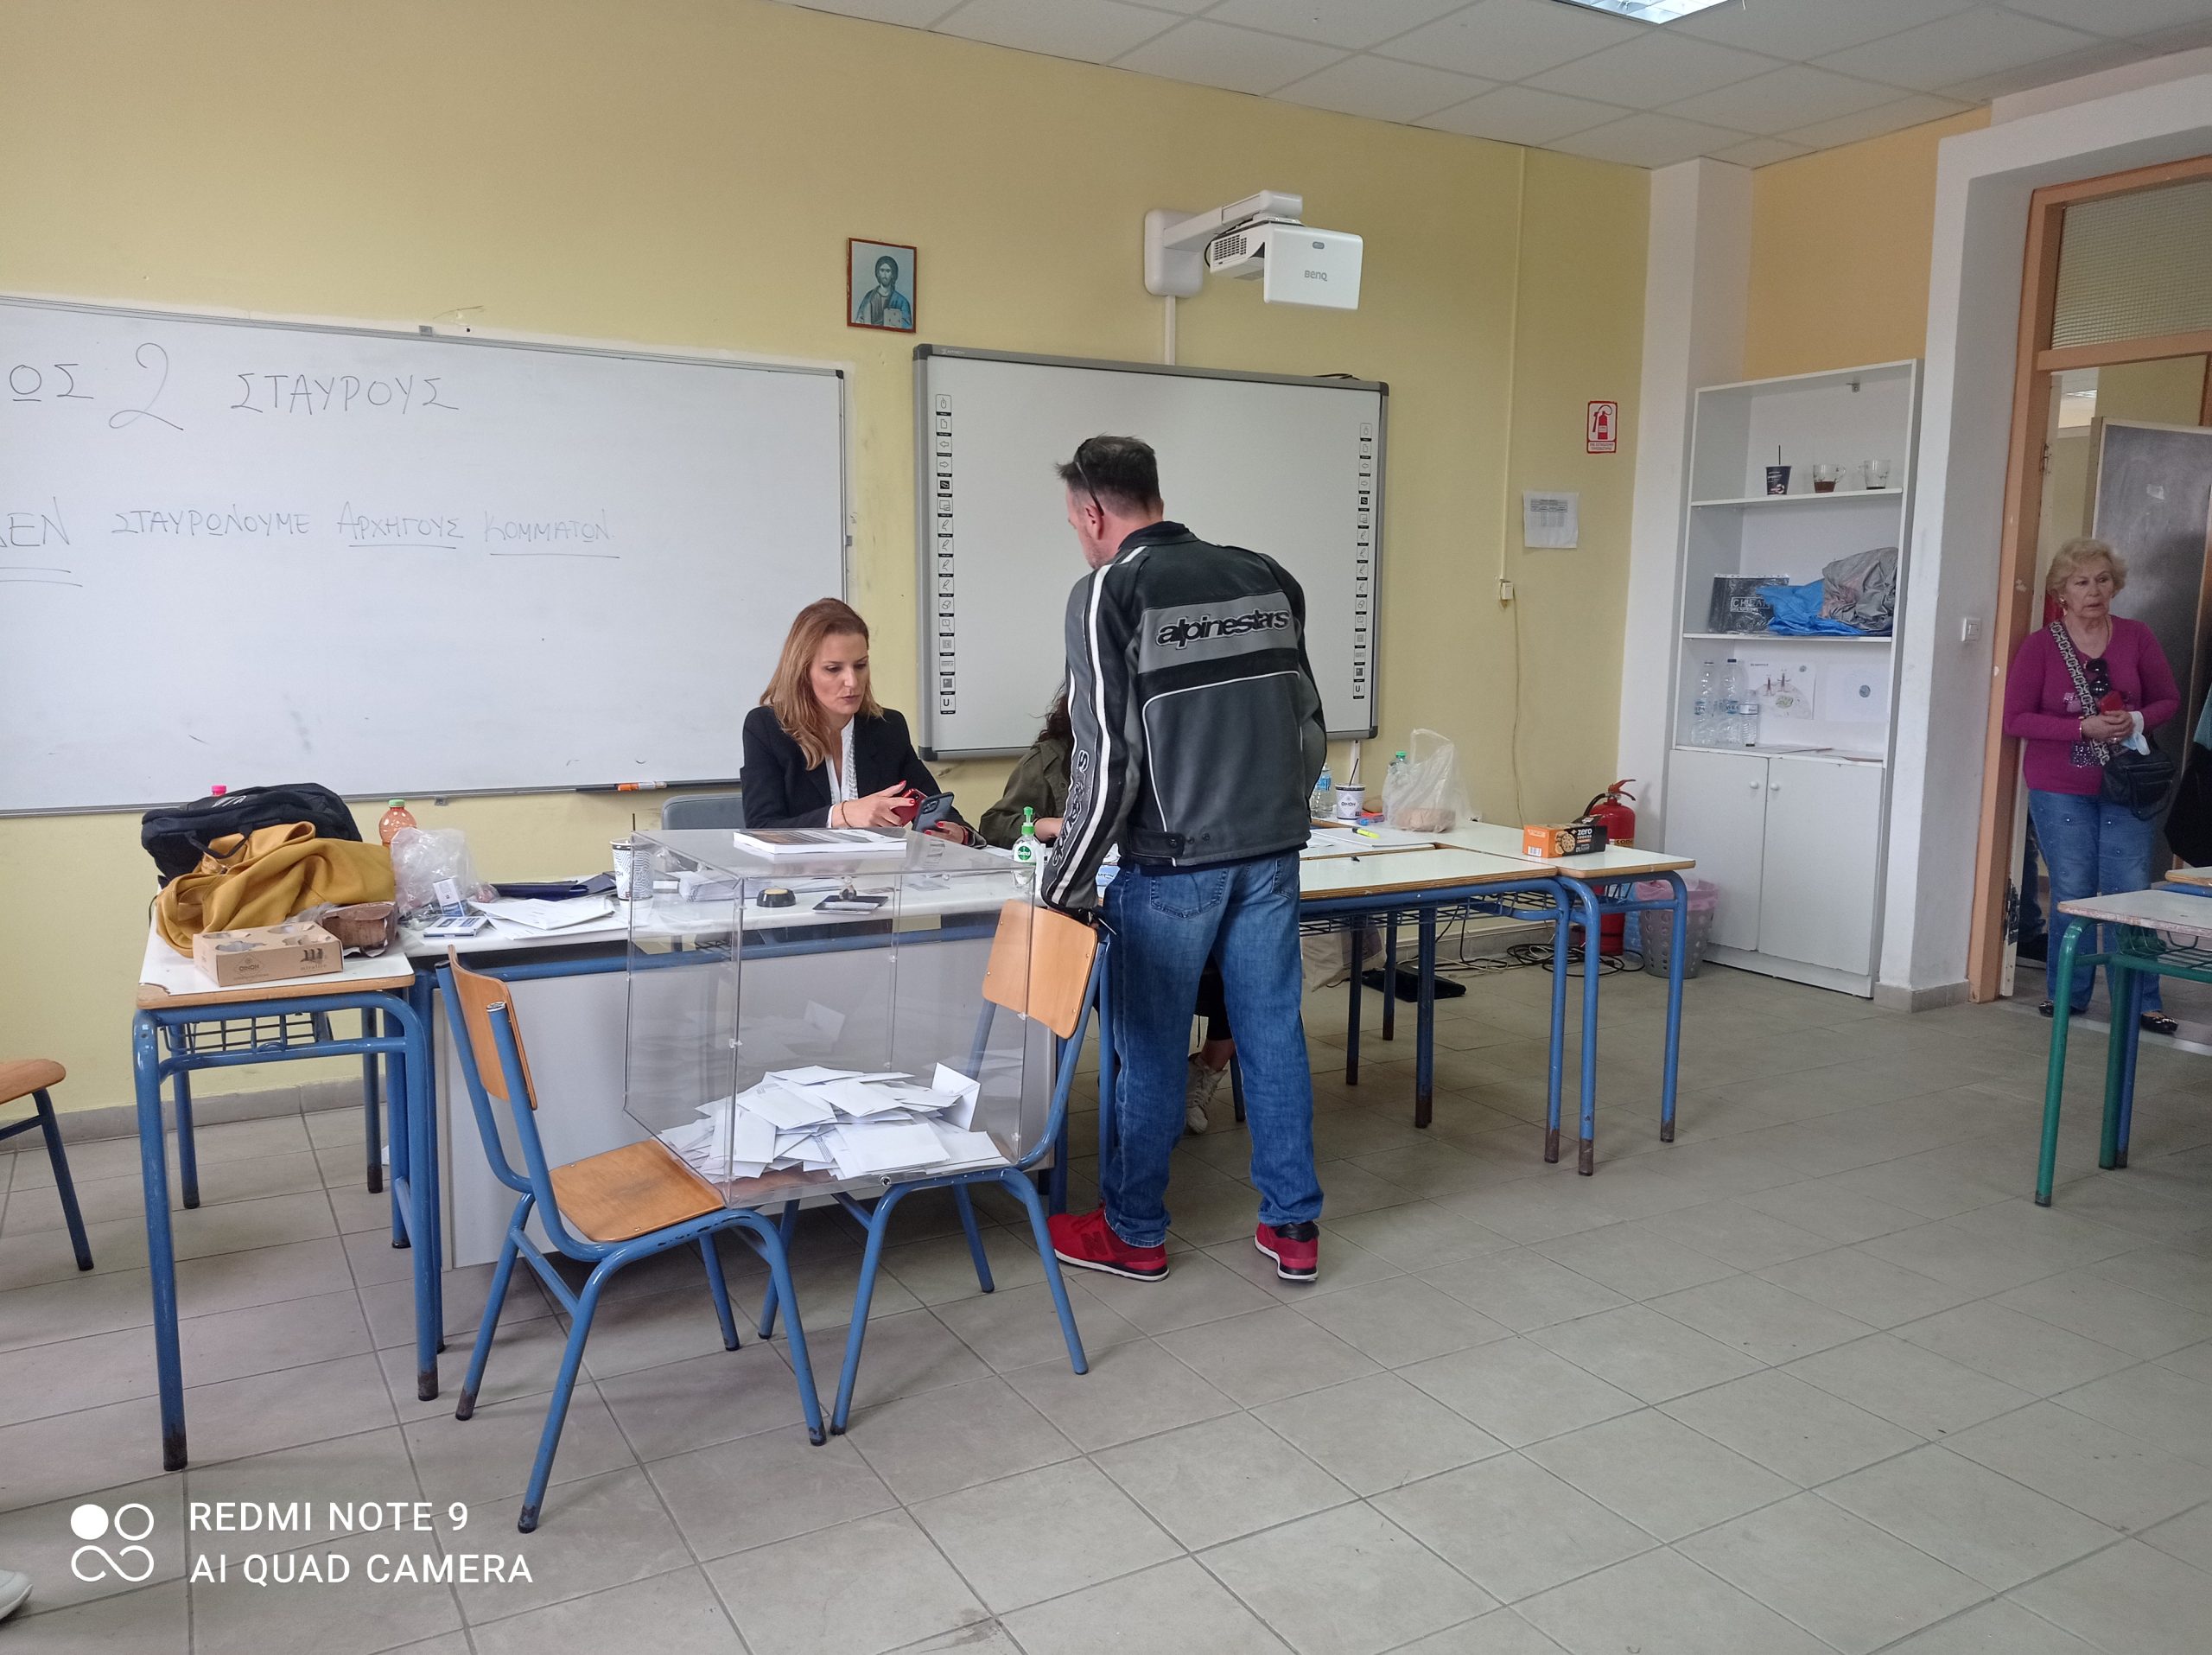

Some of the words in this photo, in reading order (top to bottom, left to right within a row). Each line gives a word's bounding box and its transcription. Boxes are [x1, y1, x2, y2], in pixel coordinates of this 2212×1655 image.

[1305, 270, 1328, 282] BenQ
[109, 343, 184, 430] 2
[231, 373, 459, 415] ΣΤΑΥΡΟΥΣ
[0, 496, 70, 547] ΕΝ
[1156, 608, 1291, 650] alpinestars
